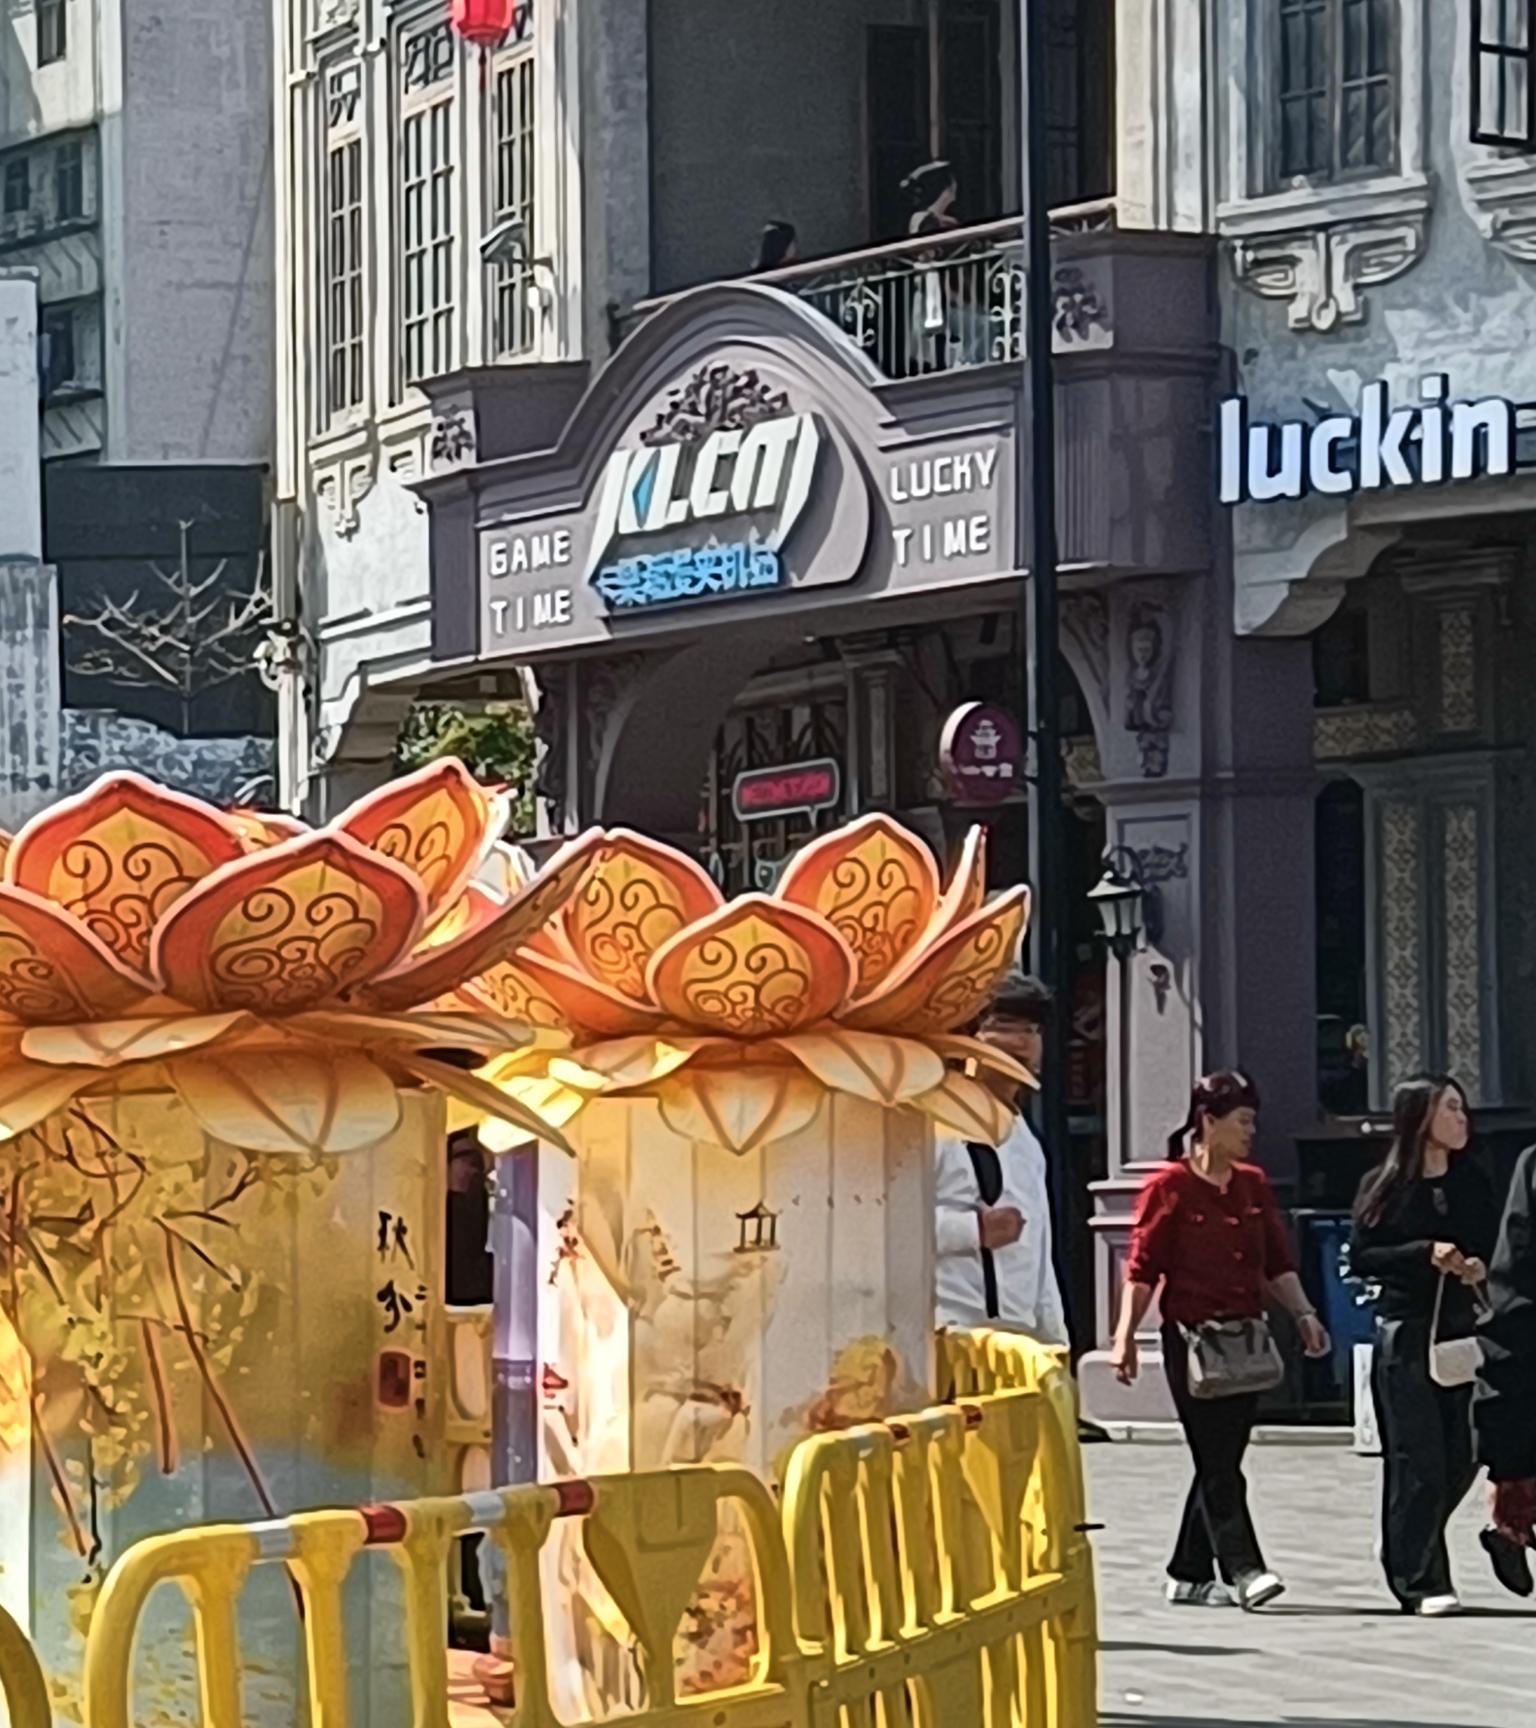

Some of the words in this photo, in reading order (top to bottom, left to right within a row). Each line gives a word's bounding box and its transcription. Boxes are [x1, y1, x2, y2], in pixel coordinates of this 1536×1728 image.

[1219, 372, 1512, 503] luckin
[890, 446, 997, 502] LUCKY
[489, 529, 571, 576] GAME
[891, 515, 989, 566] TIME
[489, 588, 571, 635] TIME
[376, 1210, 416, 1334] 秋分
